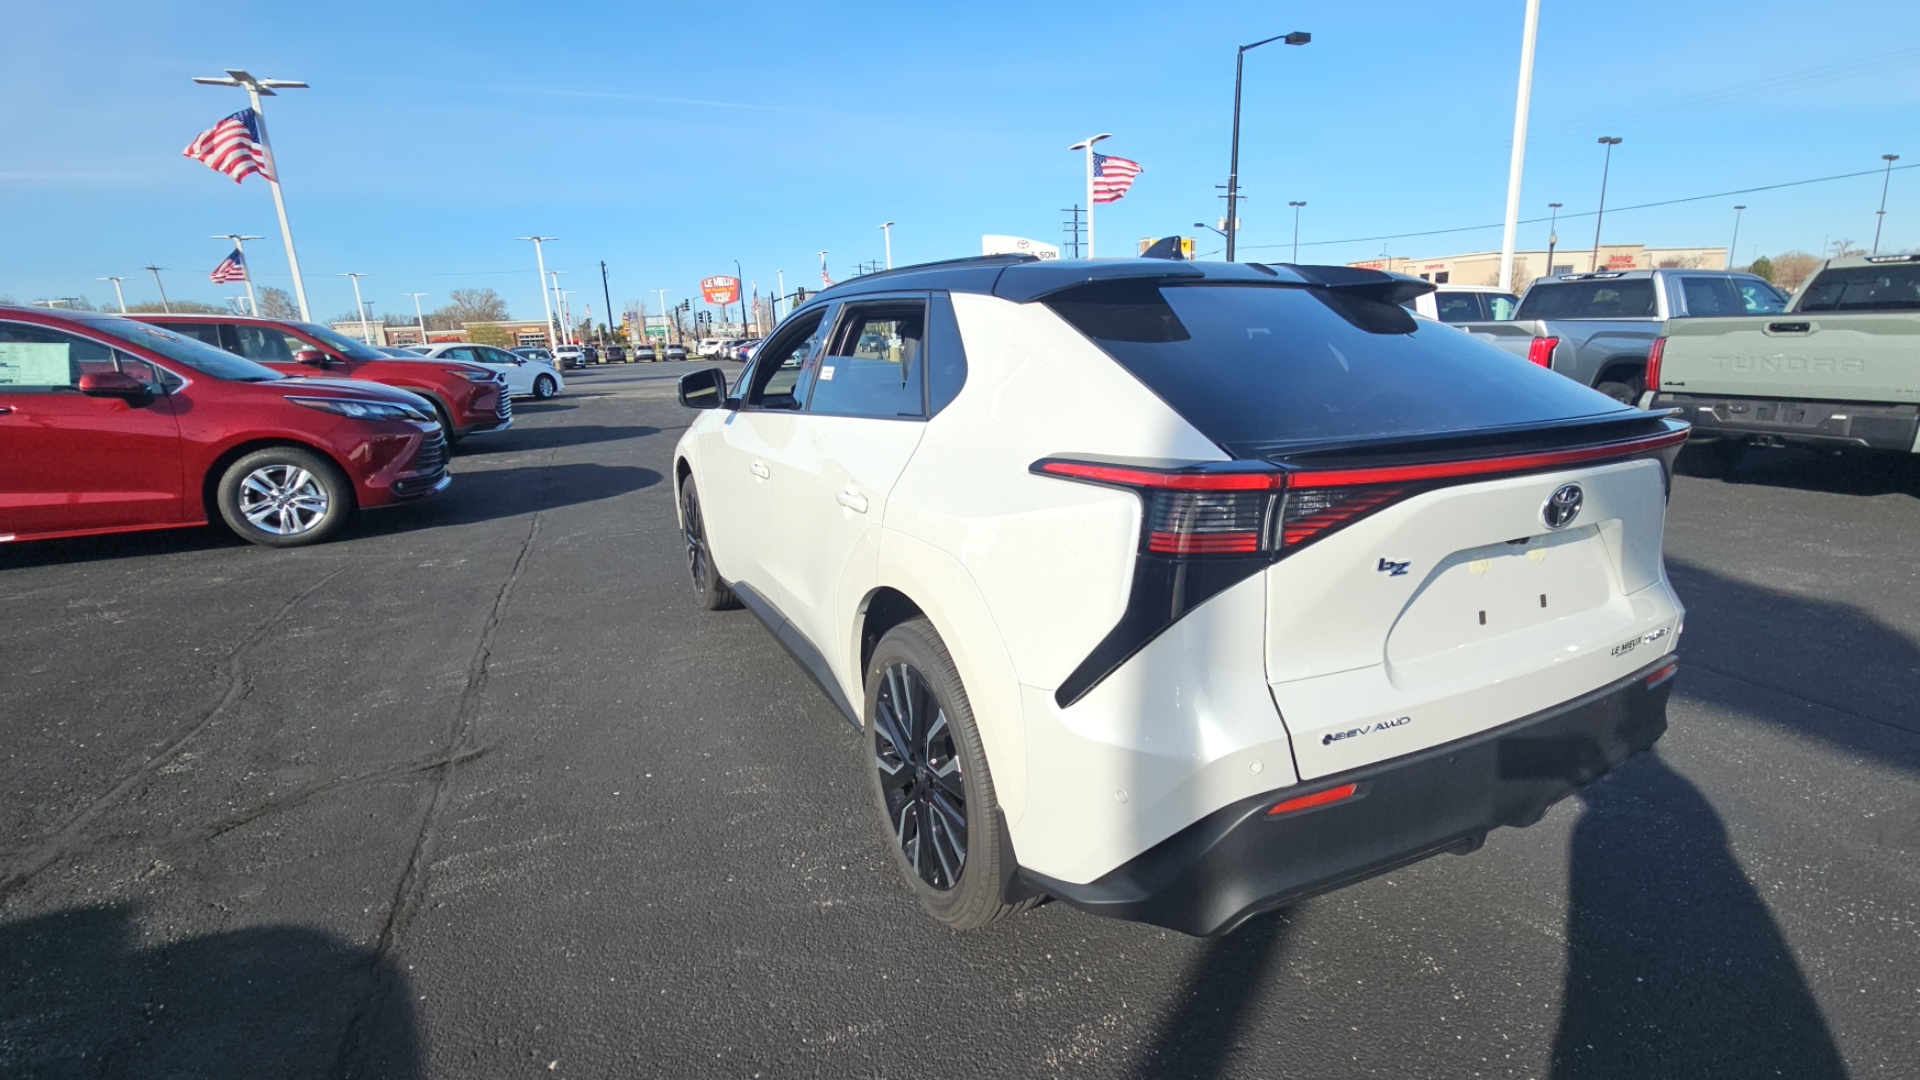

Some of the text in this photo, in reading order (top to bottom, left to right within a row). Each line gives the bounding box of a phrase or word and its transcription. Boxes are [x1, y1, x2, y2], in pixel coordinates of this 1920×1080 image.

[1039, 251, 1056, 259] SON
[1710, 355, 1866, 375] TUNDRA
[1611, 645, 1620, 656] LE
[1621, 637, 1642, 651] MIEUX
[1373, 716, 1411, 733] AWD
